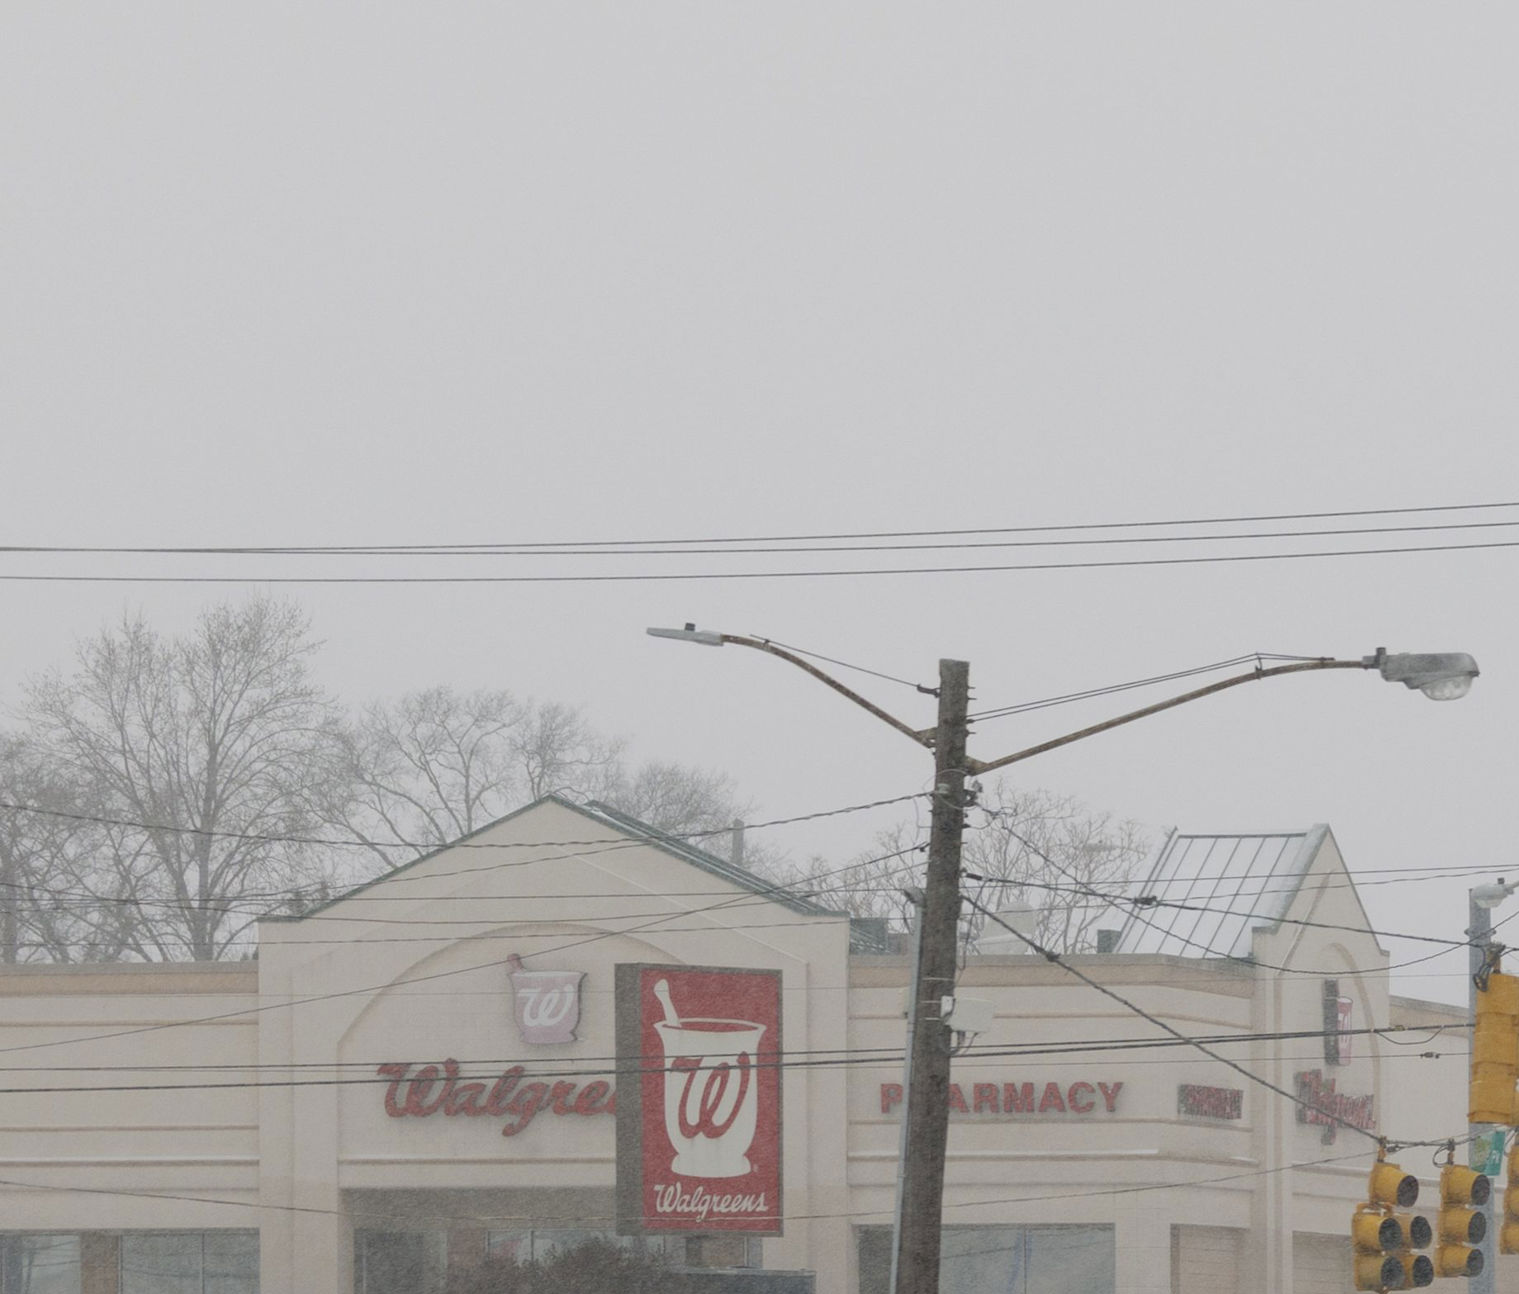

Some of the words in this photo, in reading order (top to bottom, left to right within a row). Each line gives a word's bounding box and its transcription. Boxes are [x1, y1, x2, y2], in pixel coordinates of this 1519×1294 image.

[377, 1058, 616, 1137] Walgre
[880, 1081, 1124, 1114] PARMACY
[653, 1184, 769, 1223] Walgreens
